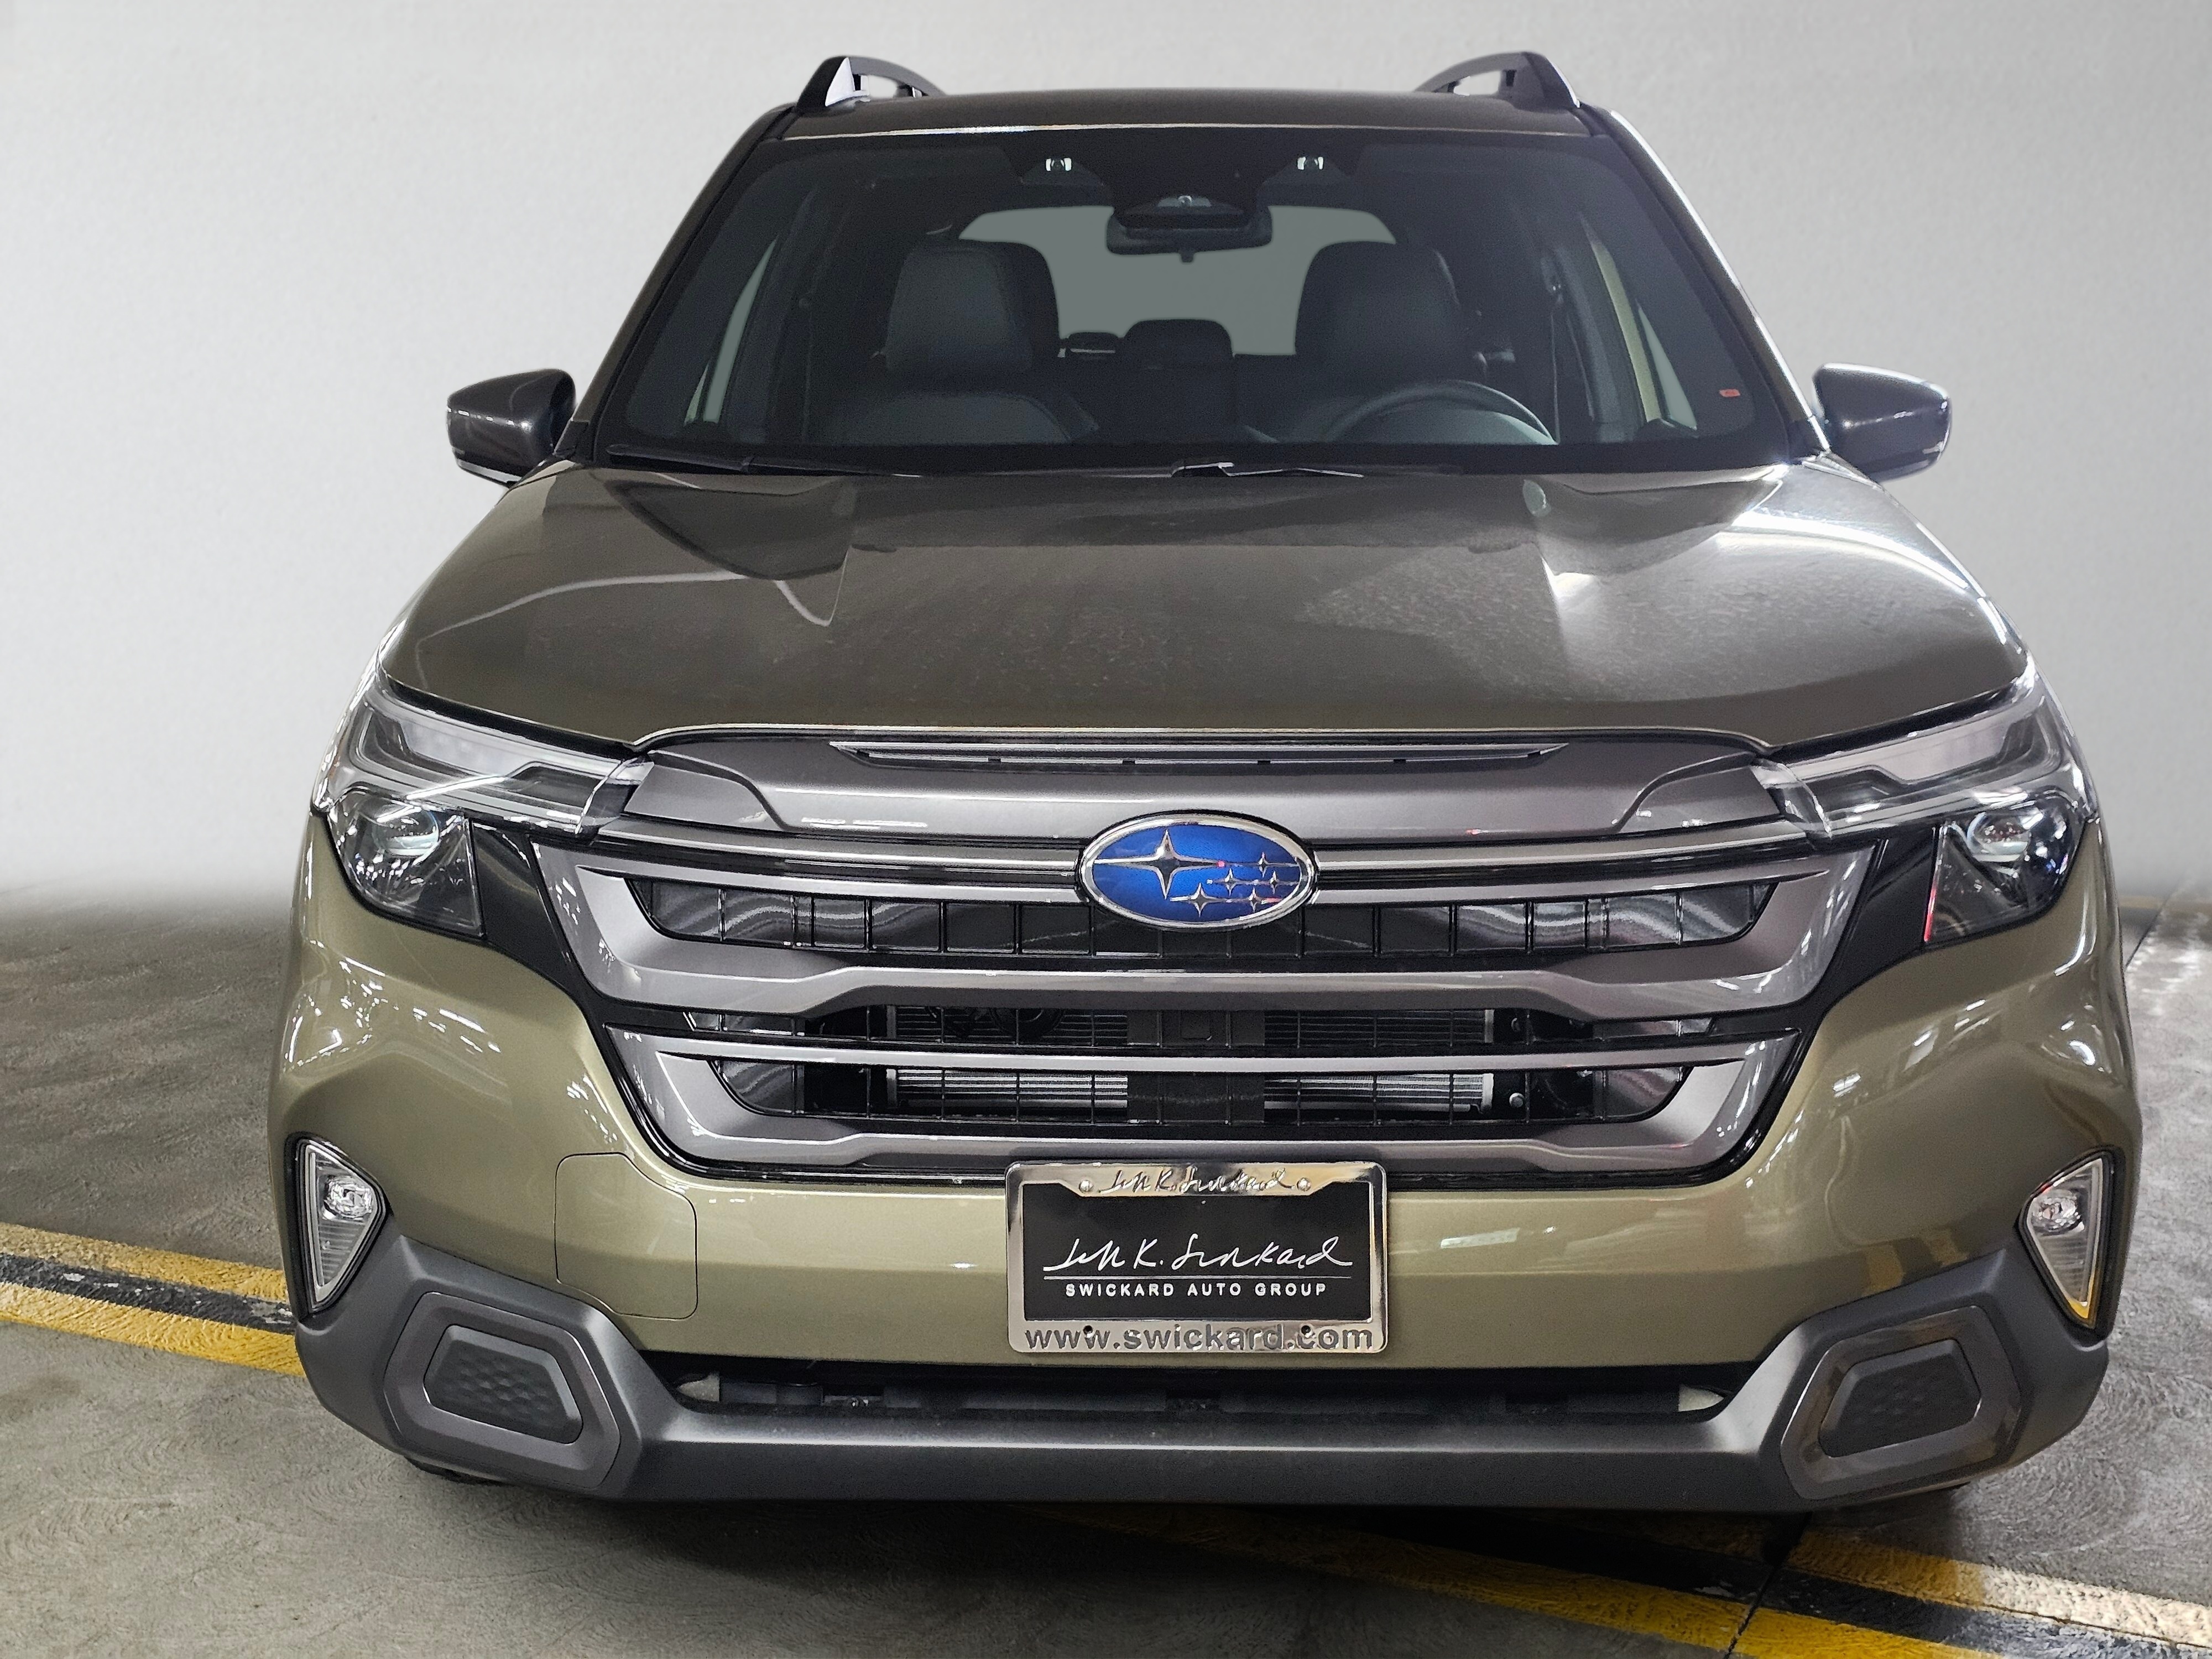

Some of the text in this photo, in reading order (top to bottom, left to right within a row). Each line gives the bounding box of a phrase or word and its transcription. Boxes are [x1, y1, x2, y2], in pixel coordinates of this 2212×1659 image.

[1133, 1238, 1164, 1269] K.
[1065, 1282, 1327, 1297] SWICKARD AUTO GROUP
[1024, 1324, 1374, 1351] www.swickard.com
